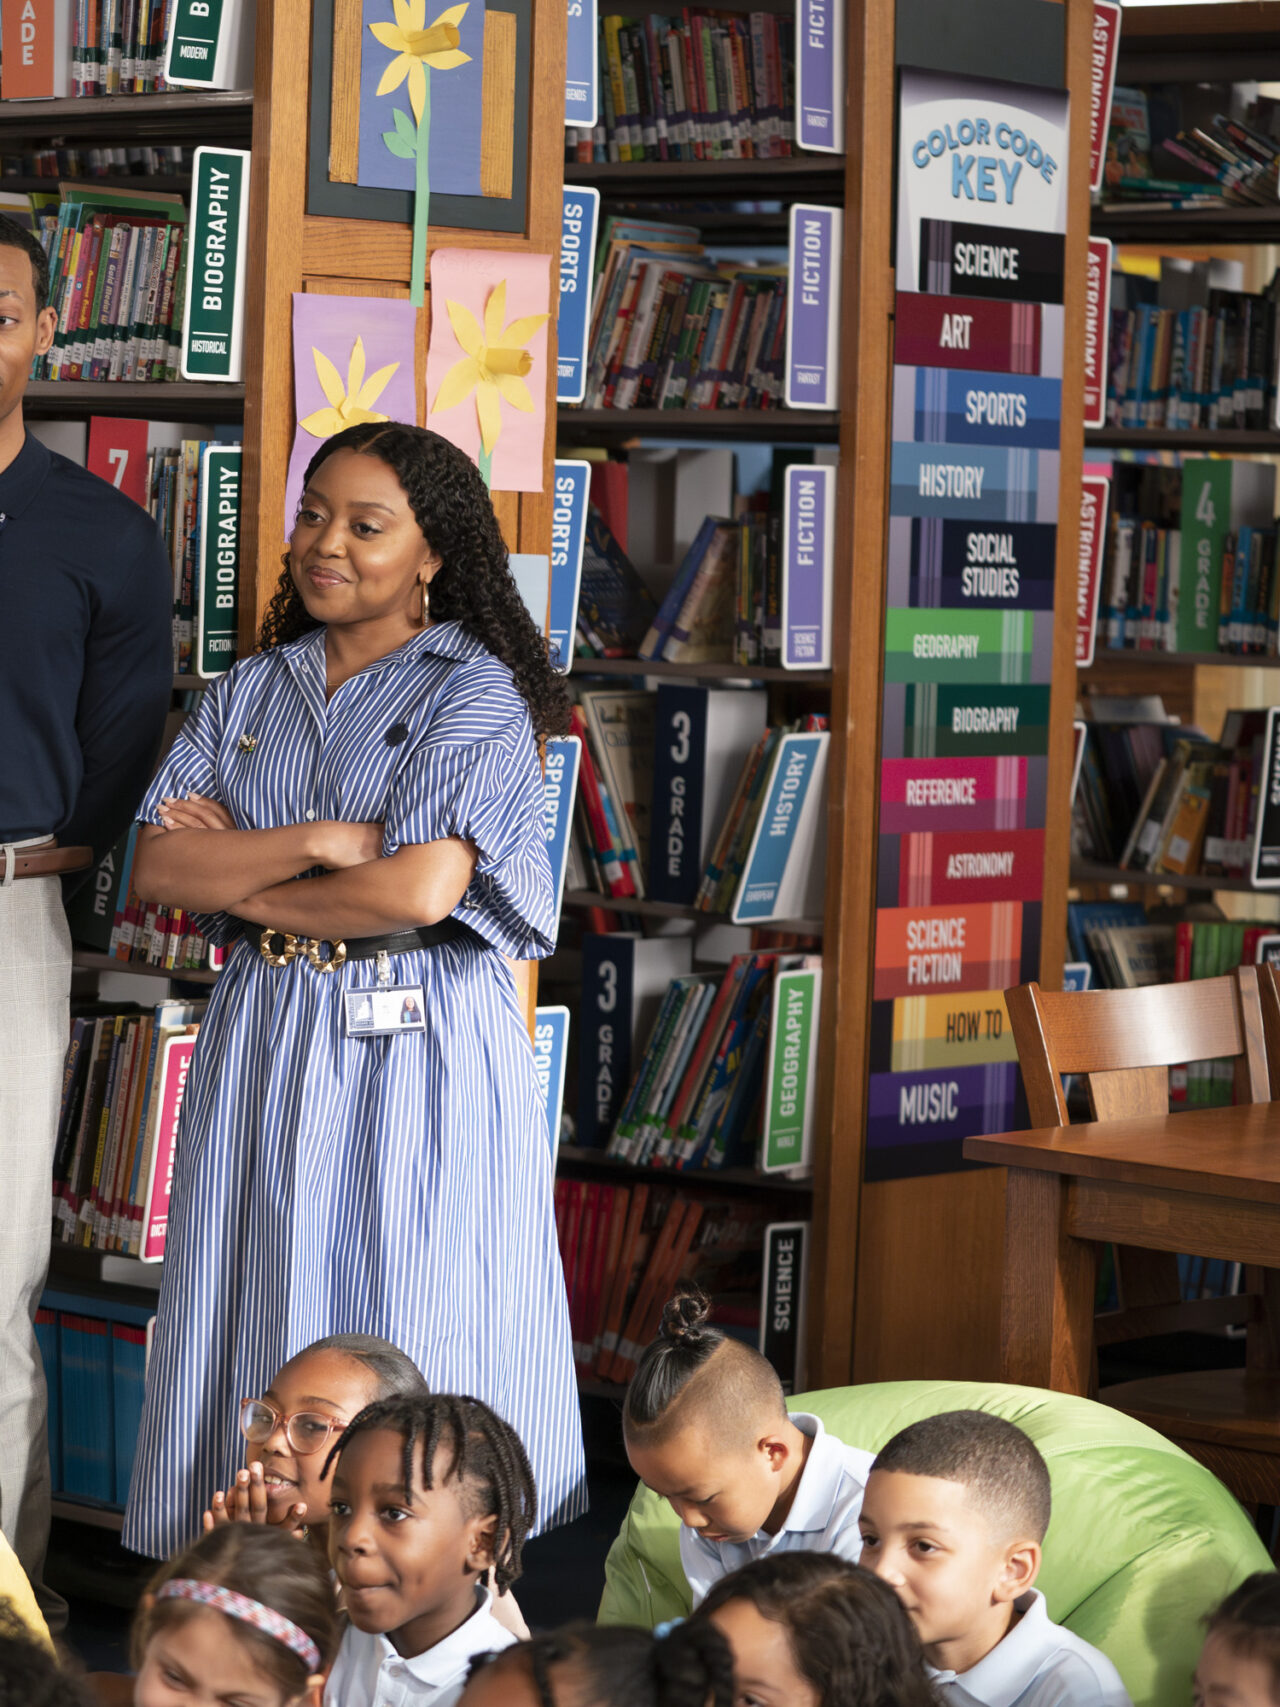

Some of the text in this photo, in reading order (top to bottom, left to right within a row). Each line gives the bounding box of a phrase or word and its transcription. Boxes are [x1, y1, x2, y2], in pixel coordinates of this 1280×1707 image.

[21, 0, 35, 66] ADE
[809, 0, 827, 49] FICT
[180, 44, 209, 61] MODERN
[912, 117, 1058, 185] COLOR CODE
[951, 153, 1022, 206] KEY
[202, 167, 231, 311] BIOGRAPHY
[560, 203, 583, 294] SPORTS
[802, 219, 822, 306] FICTION
[954, 241, 1019, 281] SCIENCE
[107, 264, 116, 285] Gold
[103, 286, 113, 313] Medal
[1084, 251, 1105, 380] ASTRONOMY
[191, 339, 227, 356] HISTORICAL
[940, 314, 973, 350] ART
[966, 389, 1027, 429] SPORTS
[108, 448, 129, 489] 7
[919, 463, 985, 499] HISTORY
[551, 477, 575, 567] SPORTS
[797, 480, 816, 566] FICTION
[1195, 481, 1217, 529] 4
[216, 466, 239, 609] BIOGRAPHY
[967, 532, 1017, 564] SOCIAL
[961, 566, 1019, 598] STUDIES
[1195, 538, 1213, 629] GRADE
[208, 639, 232, 653] FICTION
[912, 634, 980, 659] GEOGRAPHY
[670, 711, 692, 764] 3
[952, 706, 1019, 733] BIOGRAPHY
[769, 751, 808, 837] HISTORY
[906, 778, 976, 806] REFERENCE
[667, 776, 688, 877] GRADE
[93, 850, 116, 916] ADE
[946, 852, 1015, 880] ASTRONOMY
[907, 917, 966, 951] SCIENCE
[597, 960, 618, 1013] 3
[907, 952, 962, 986] FICTION
[946, 1009, 1003, 1043] HOW TO
[534, 1023, 555, 1109] SPORT
[595, 1025, 614, 1123] GRADE
[780, 988, 804, 1117] GEOGRAPHY
[899, 1081, 959, 1125] MUSIC
[773, 1238, 795, 1331] SCIENCE
